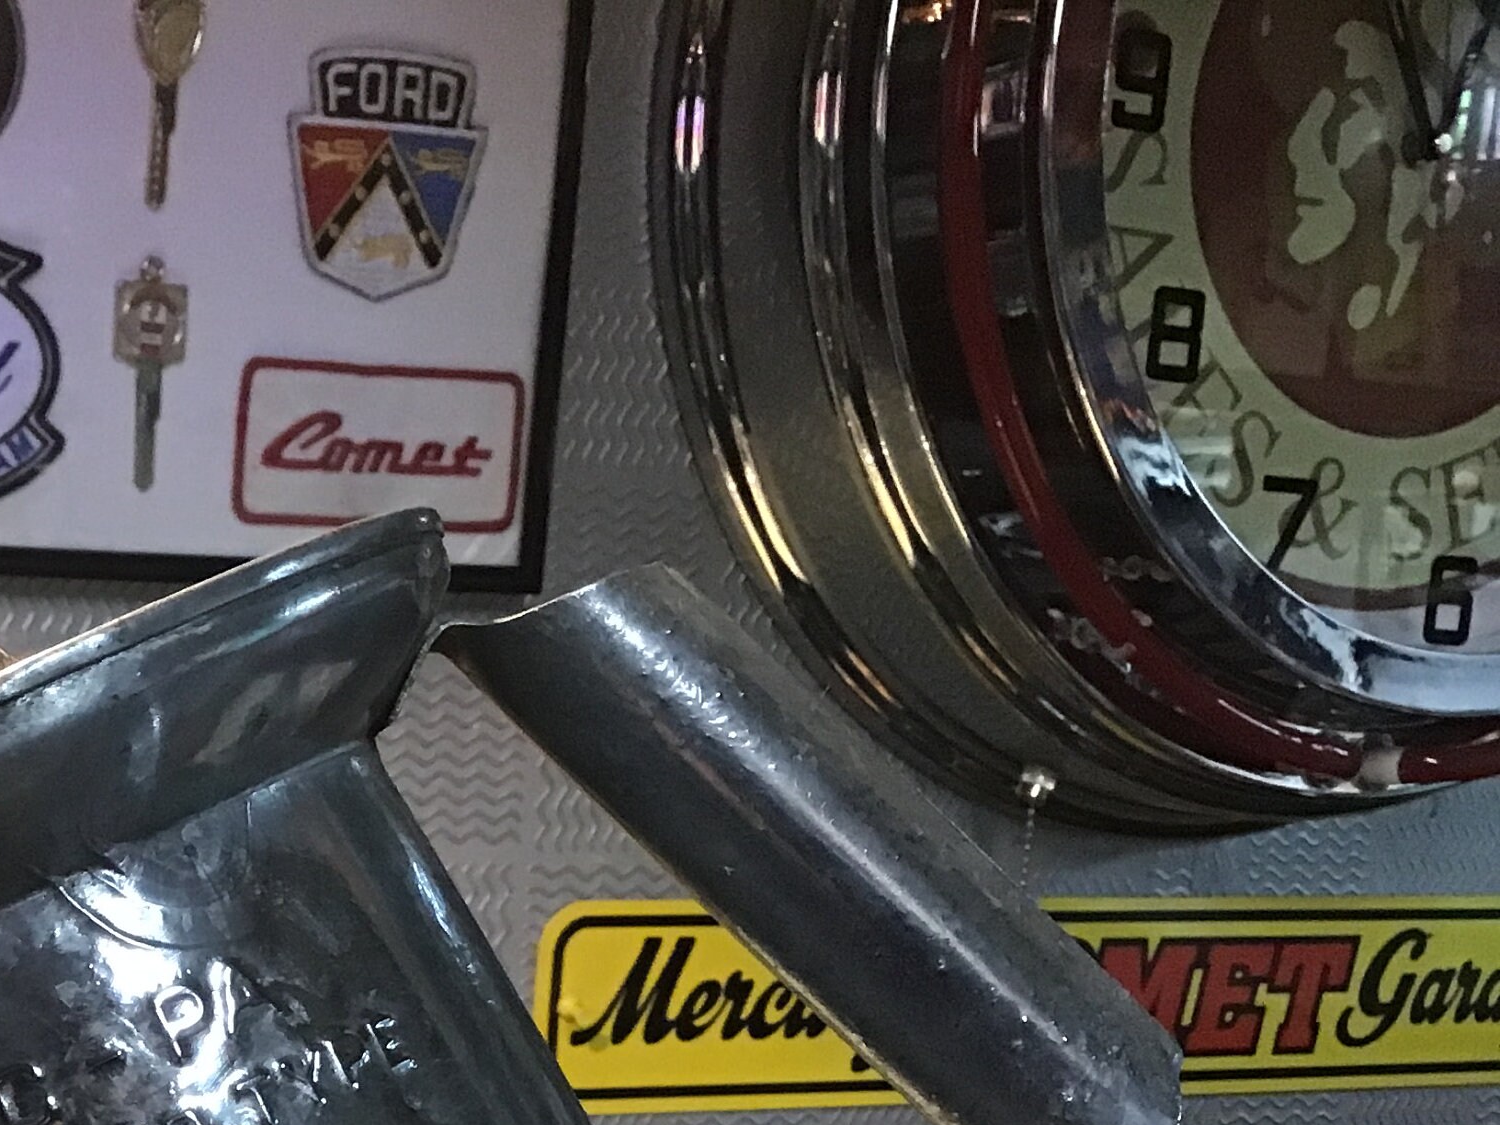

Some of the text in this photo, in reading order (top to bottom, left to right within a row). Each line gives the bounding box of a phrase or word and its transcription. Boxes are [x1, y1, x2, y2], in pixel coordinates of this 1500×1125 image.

[327, 60, 461, 121] FORD
[1145, 285, 1206, 383] 8
[261, 409, 493, 479] Comet
[1263, 474, 1319, 573] 7
[1422, 554, 1479, 646] 6
[1072, 935, 1362, 1057] MET
